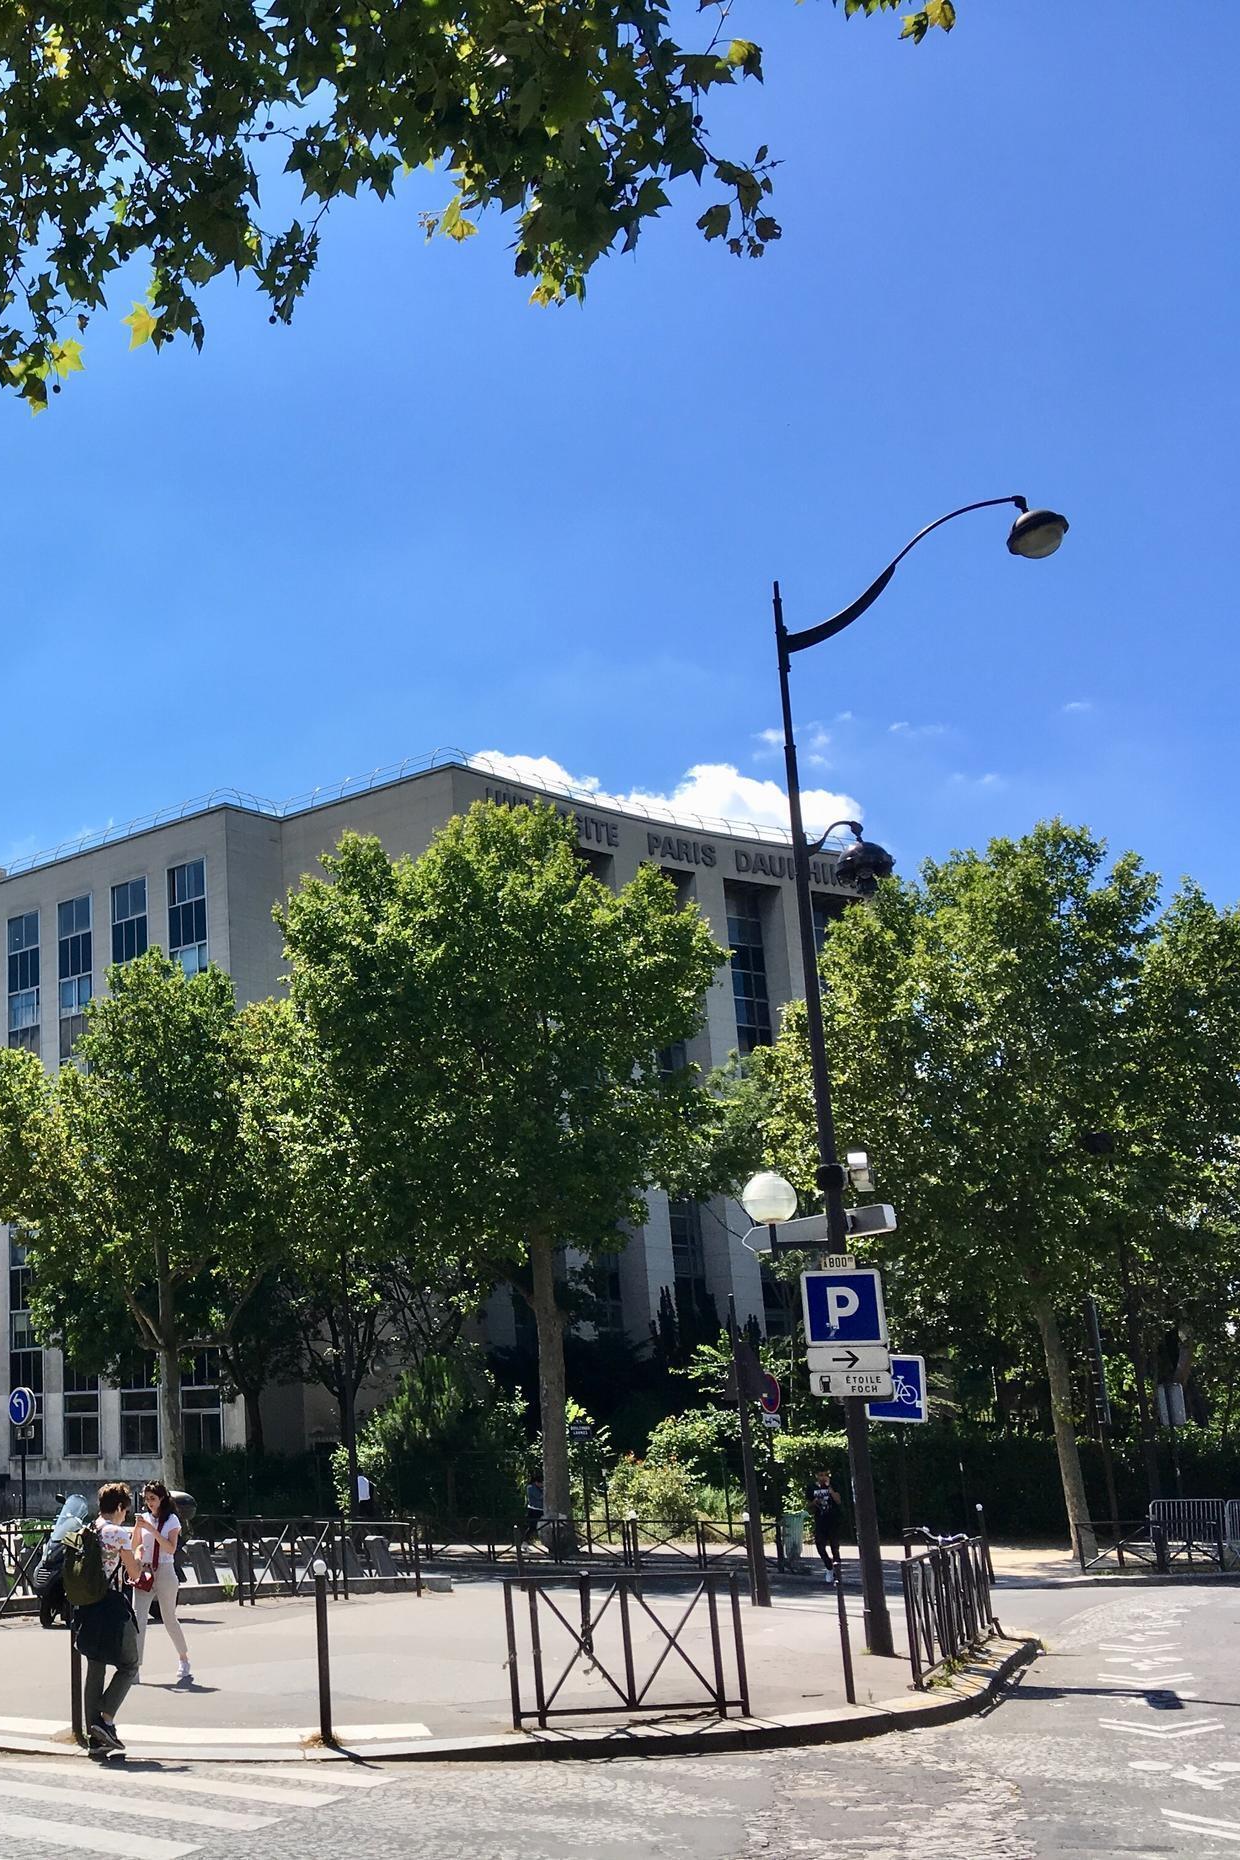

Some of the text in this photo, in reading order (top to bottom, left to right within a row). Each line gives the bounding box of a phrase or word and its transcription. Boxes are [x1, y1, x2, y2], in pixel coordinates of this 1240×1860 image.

[647, 831, 717, 867] PARIS
[825, 1286, 860, 1330] P
[845, 1374, 882, 1384] ÉTOILE
[851, 1385, 878, 1393] FOCH
